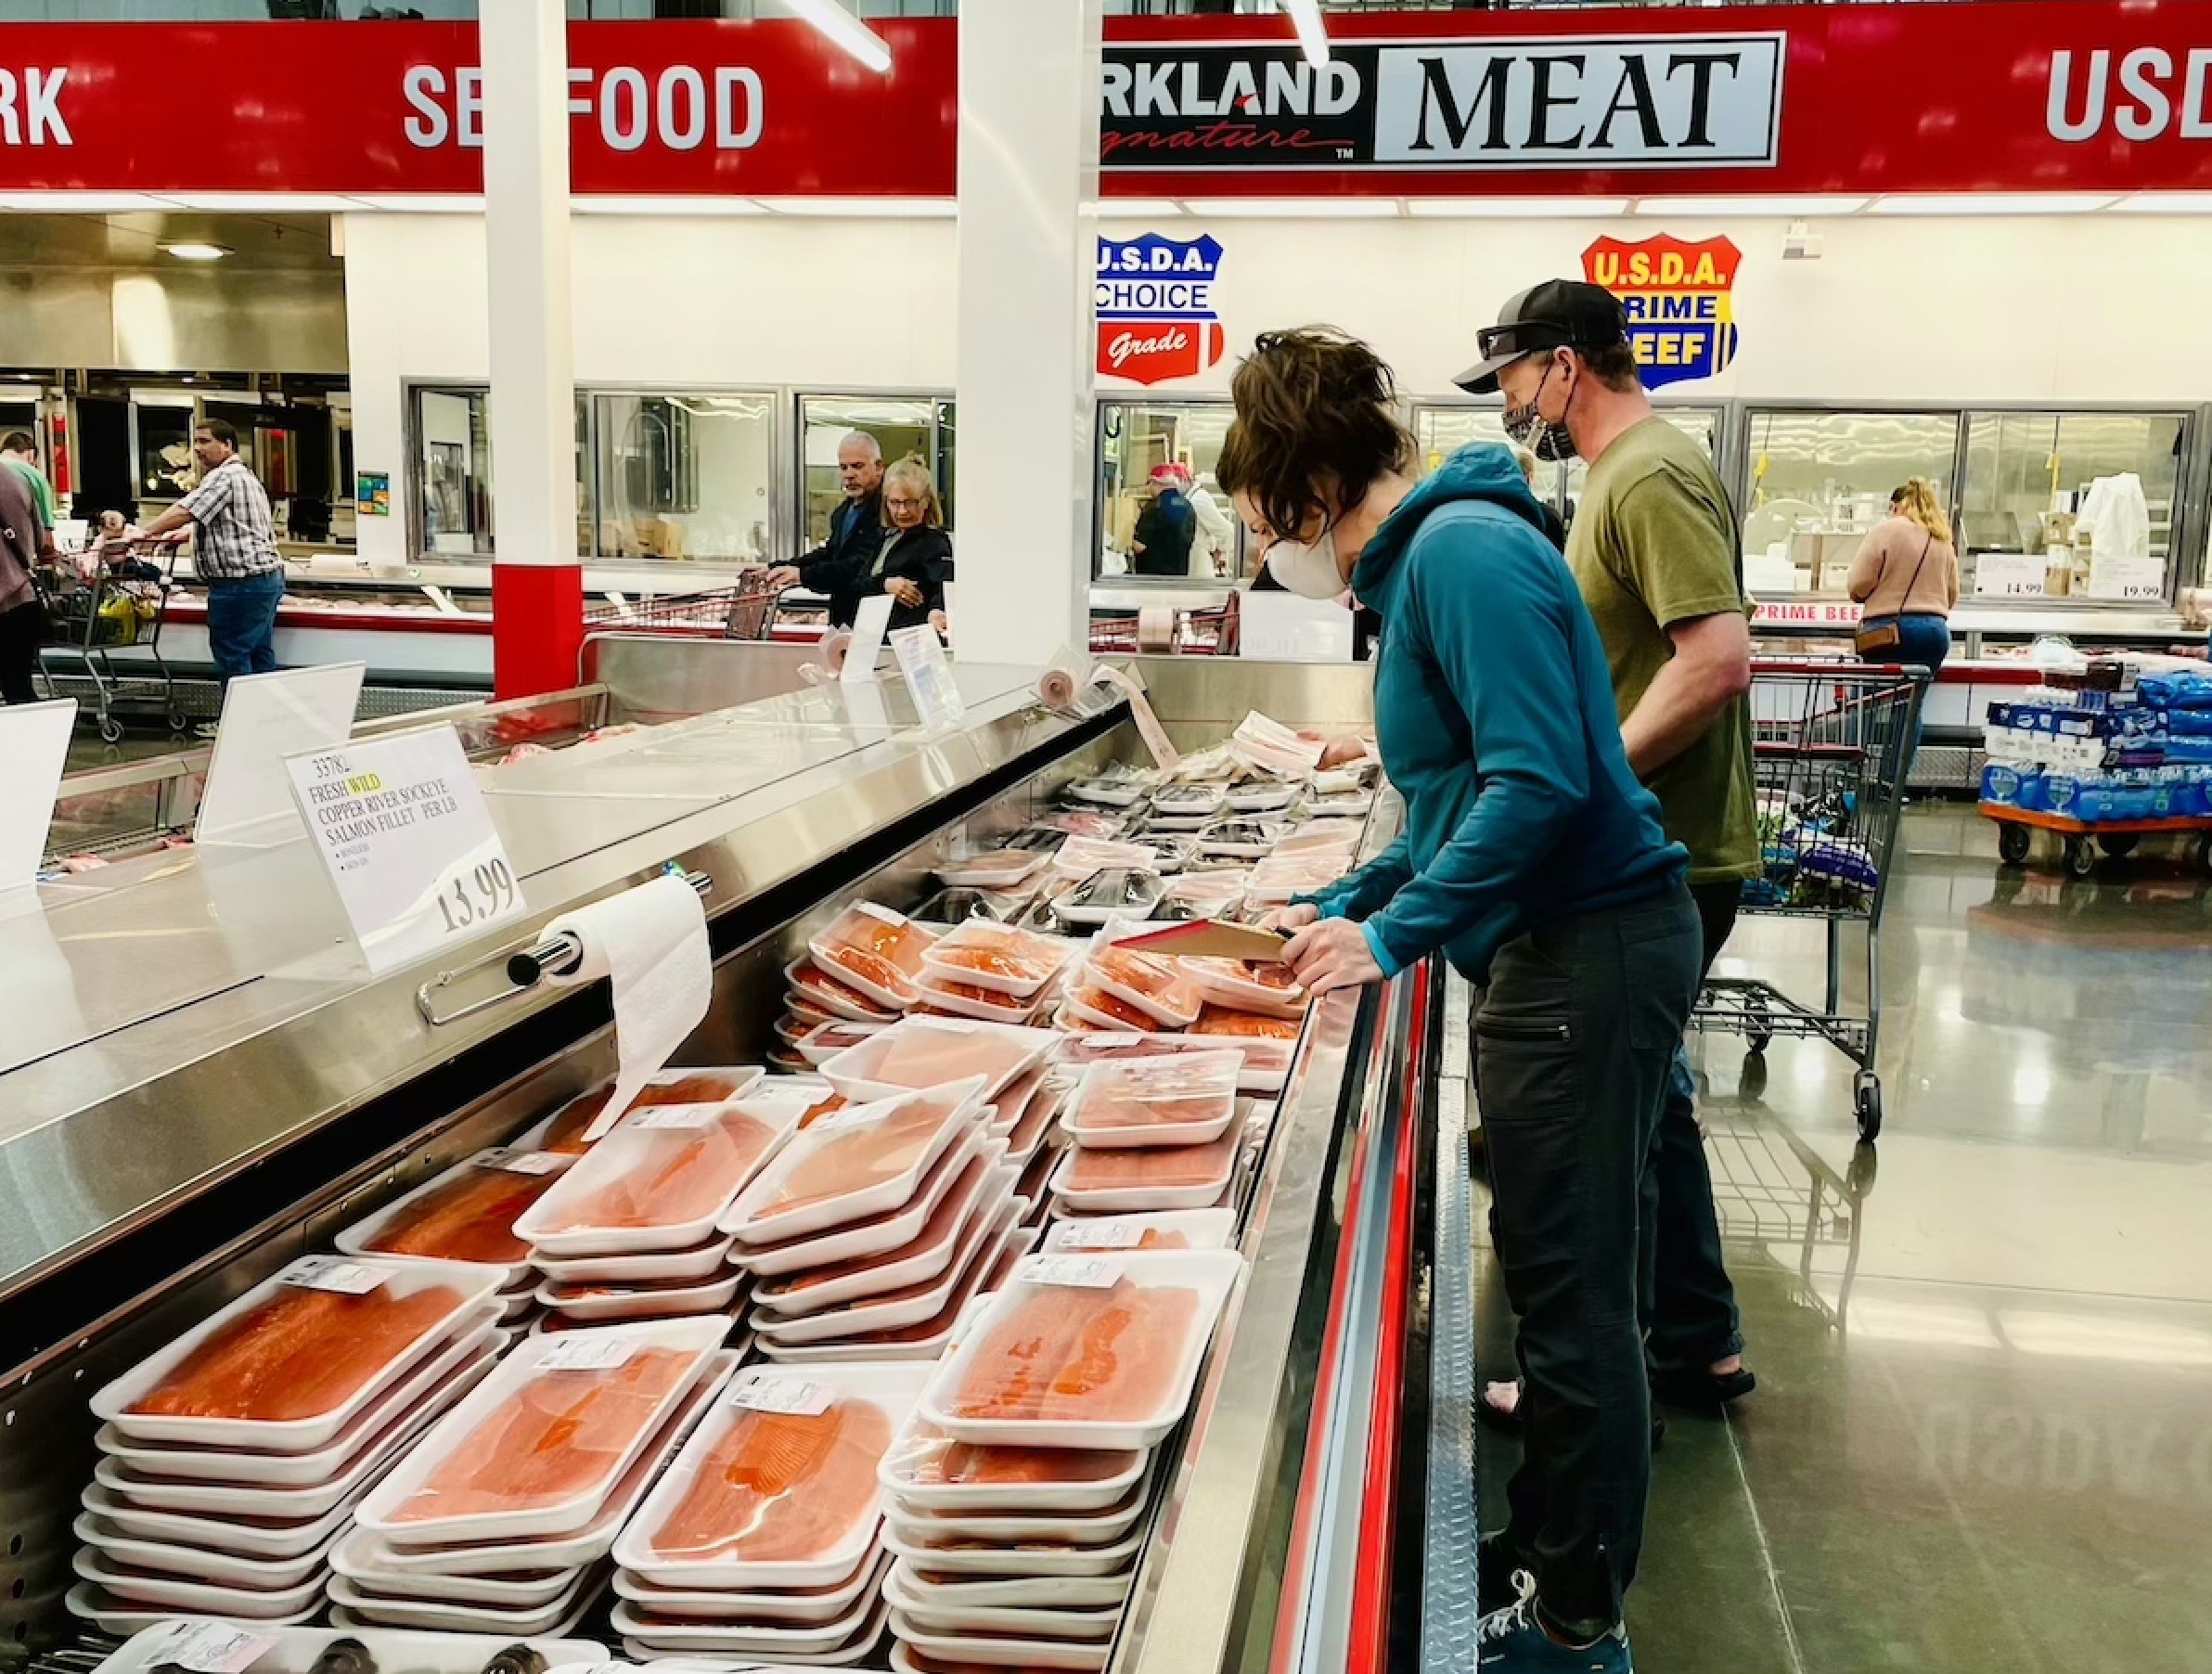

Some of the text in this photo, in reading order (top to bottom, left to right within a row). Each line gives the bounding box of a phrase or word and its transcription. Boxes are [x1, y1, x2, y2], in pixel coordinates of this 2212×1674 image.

[0, 67, 73, 146] RK
[403, 64, 764, 150] SEFOOD
[1101, 60, 1361, 116] RKLAND
[1408, 52, 1741, 149] MEAT
[1101, 121, 1355, 160] gnature
[1595, 252, 1727, 287] U.S.D.A.
[1096, 284, 1208, 308] CHOICE
[1625, 296, 1717, 318] RIME
[1108, 327, 1189, 367] Grade
[1632, 333, 1705, 365] EEF
[1755, 605, 1859, 621] PRIME BEE
[309, 774, 381, 804] FRESH WILD
[317, 779, 449, 824] COPPER RIVER SOCKEYE
[326, 818, 378, 845] SALMON
[377, 807, 416, 831] FILLET
[421, 802, 444, 819] PER
[436, 857, 513, 934] 13.99
